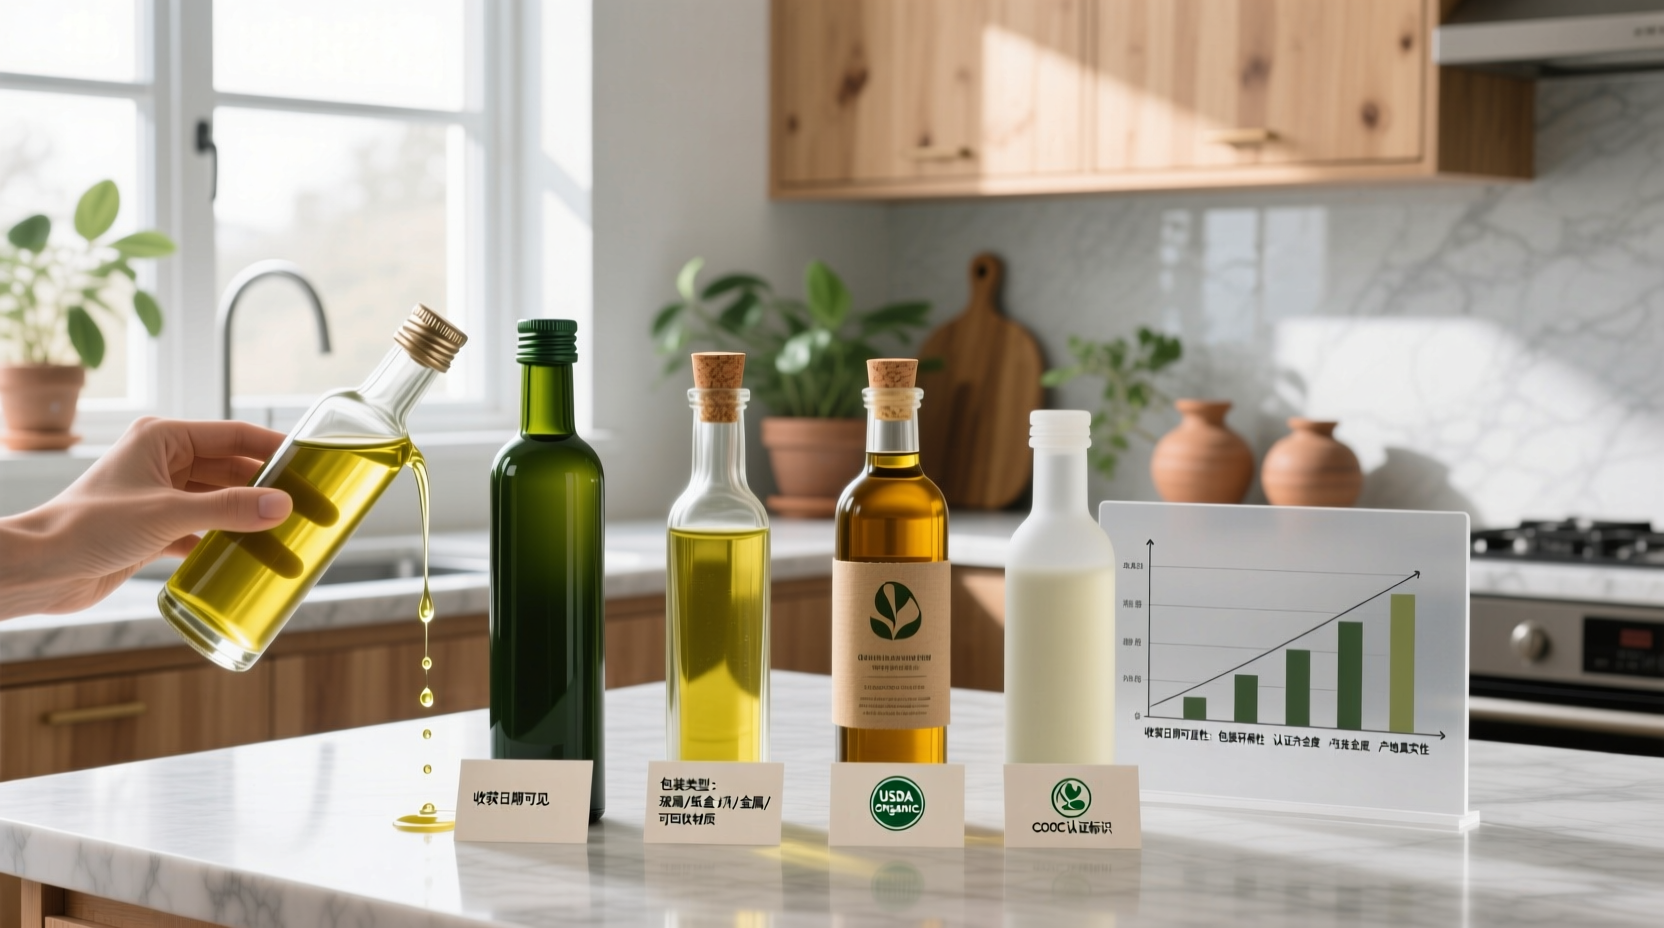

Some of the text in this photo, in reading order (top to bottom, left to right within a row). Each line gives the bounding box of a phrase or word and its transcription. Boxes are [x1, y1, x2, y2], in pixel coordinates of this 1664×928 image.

[473, 791, 550, 806] 收获日期可见
[879, 789, 914, 803] USDA
